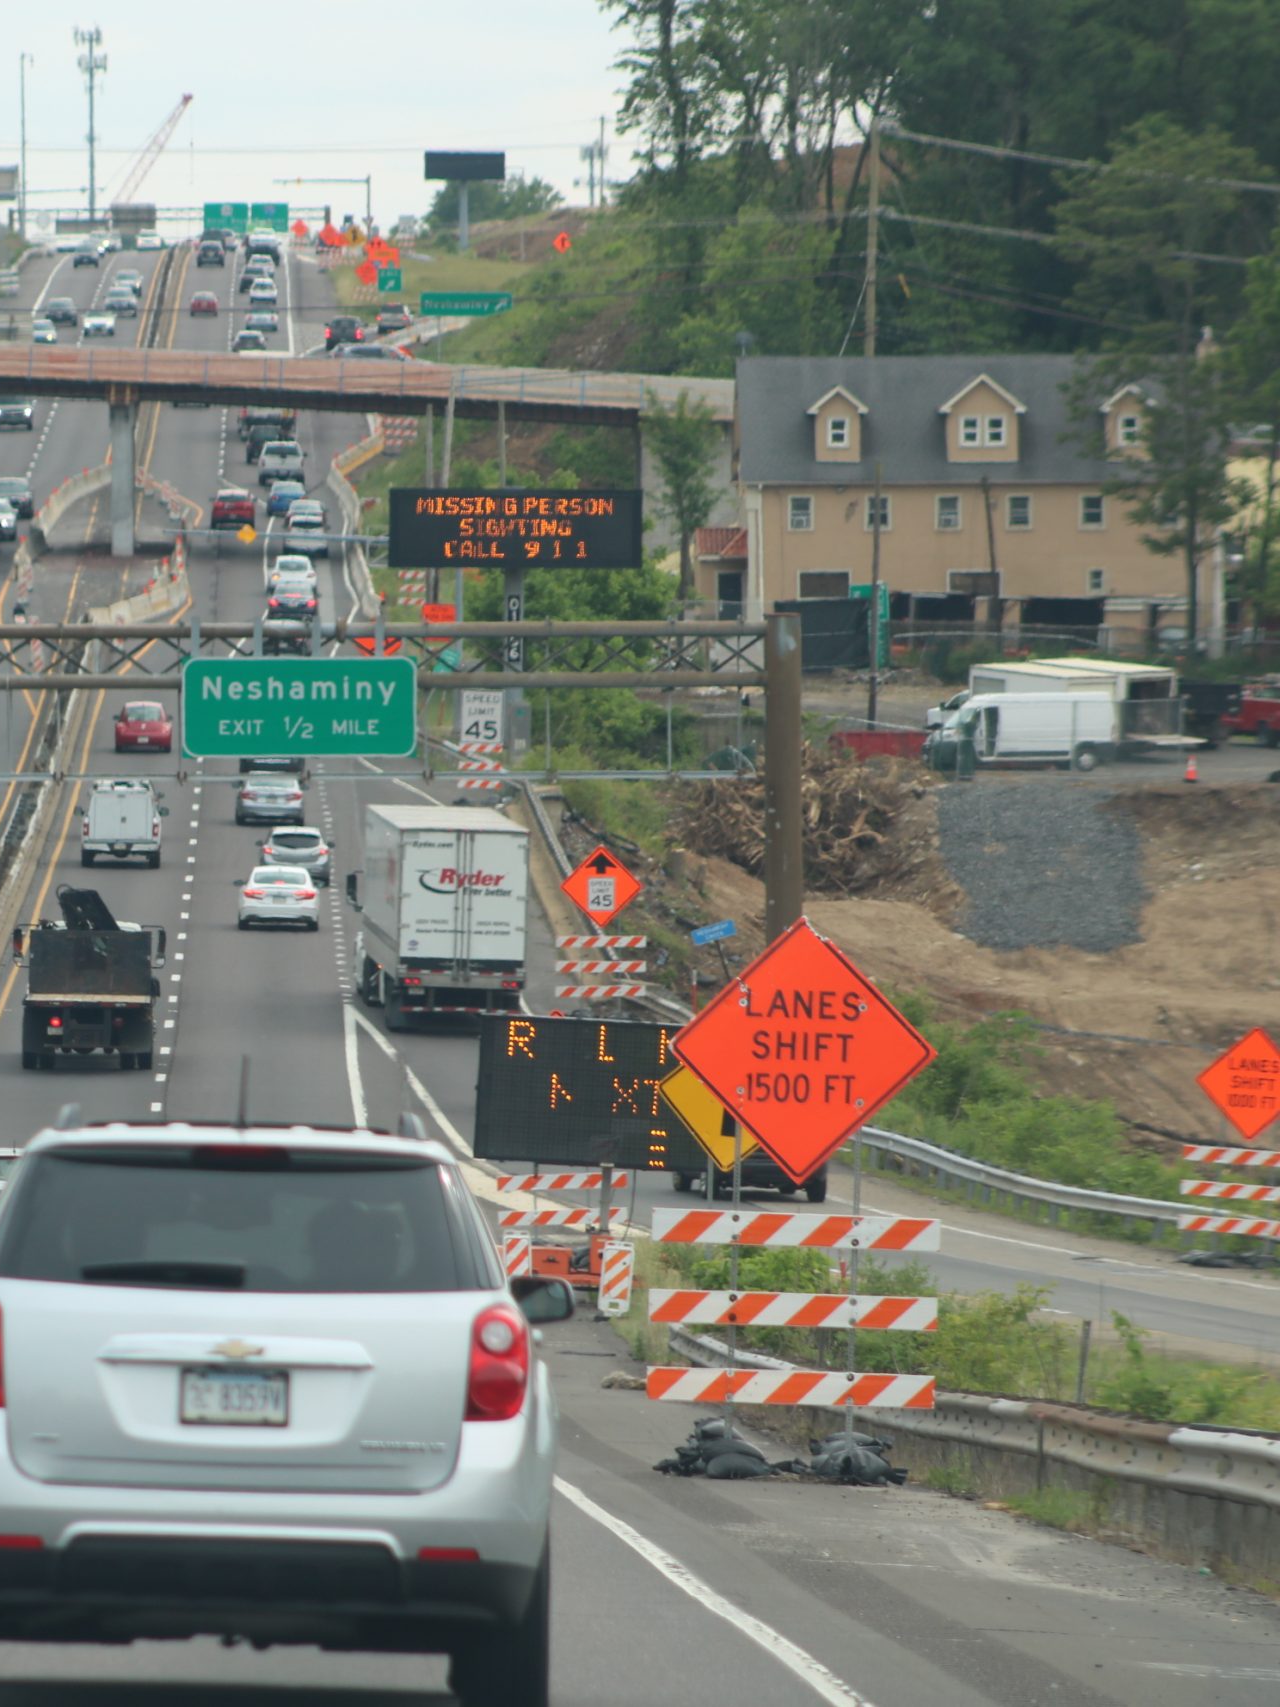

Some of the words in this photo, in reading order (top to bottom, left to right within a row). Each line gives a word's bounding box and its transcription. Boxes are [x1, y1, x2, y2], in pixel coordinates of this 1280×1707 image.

[424, 299, 490, 311] Neshaminy
[416, 497, 517, 515] MISSING
[522, 497, 613, 515] PERSON
[444, 540, 505, 558] CALL
[202, 676, 396, 706] Neshaminy
[464, 694, 500, 704] SPEED
[468, 707, 495, 716] LIMIT
[219, 719, 264, 736] EXIT
[283, 716, 315, 739] 1/2
[331, 719, 380, 736] MILE
[465, 720, 498, 740] 45
[439, 868, 505, 888] Ryder
[485, 888, 512, 897] better
[590, 894, 613, 907] 45
[746, 988, 861, 1021] LANES
[752, 1030, 854, 1062] SHIFT
[746, 1073, 810, 1103] 1500
[825, 1074, 856, 1104] FT
